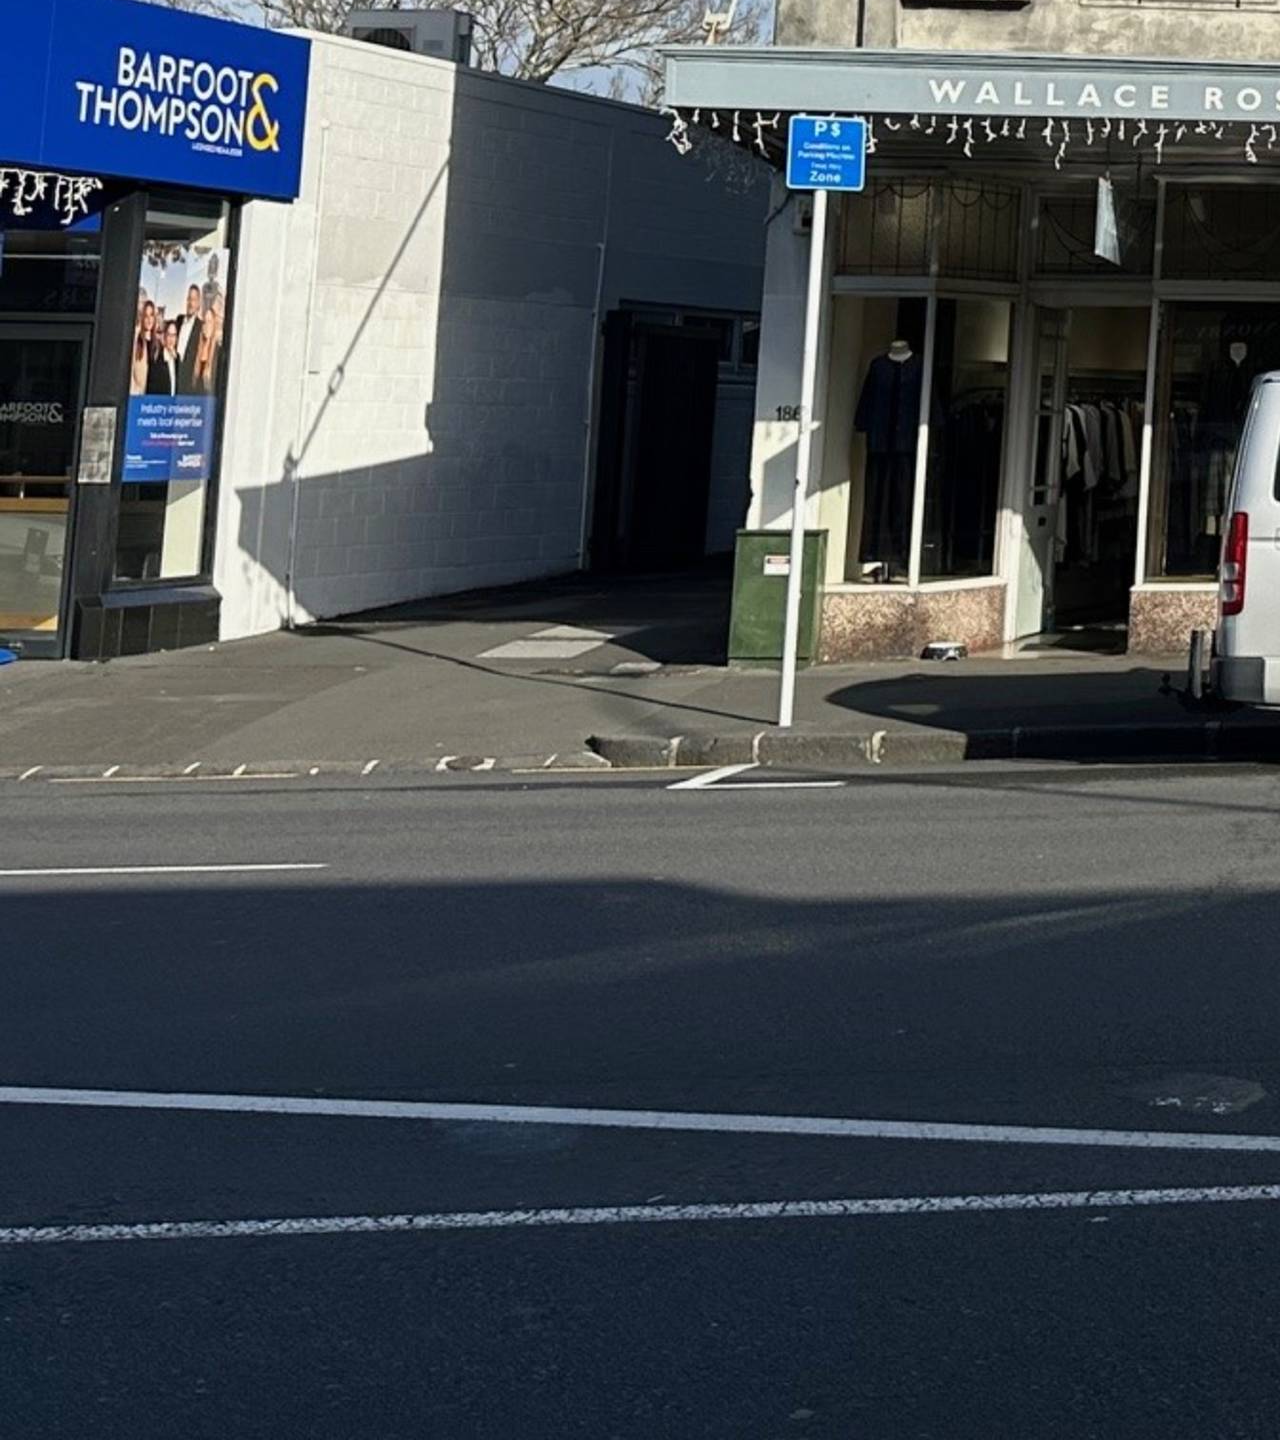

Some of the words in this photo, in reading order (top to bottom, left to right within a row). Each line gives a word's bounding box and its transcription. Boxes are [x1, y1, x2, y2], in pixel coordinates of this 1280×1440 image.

[75, 81, 245, 146] THOMPSON
[116, 47, 254, 107] BARFOOT
[246, 73, 280, 152] &
[929, 79, 1169, 108] WALLACE
[809, 171, 841, 183] Zone
